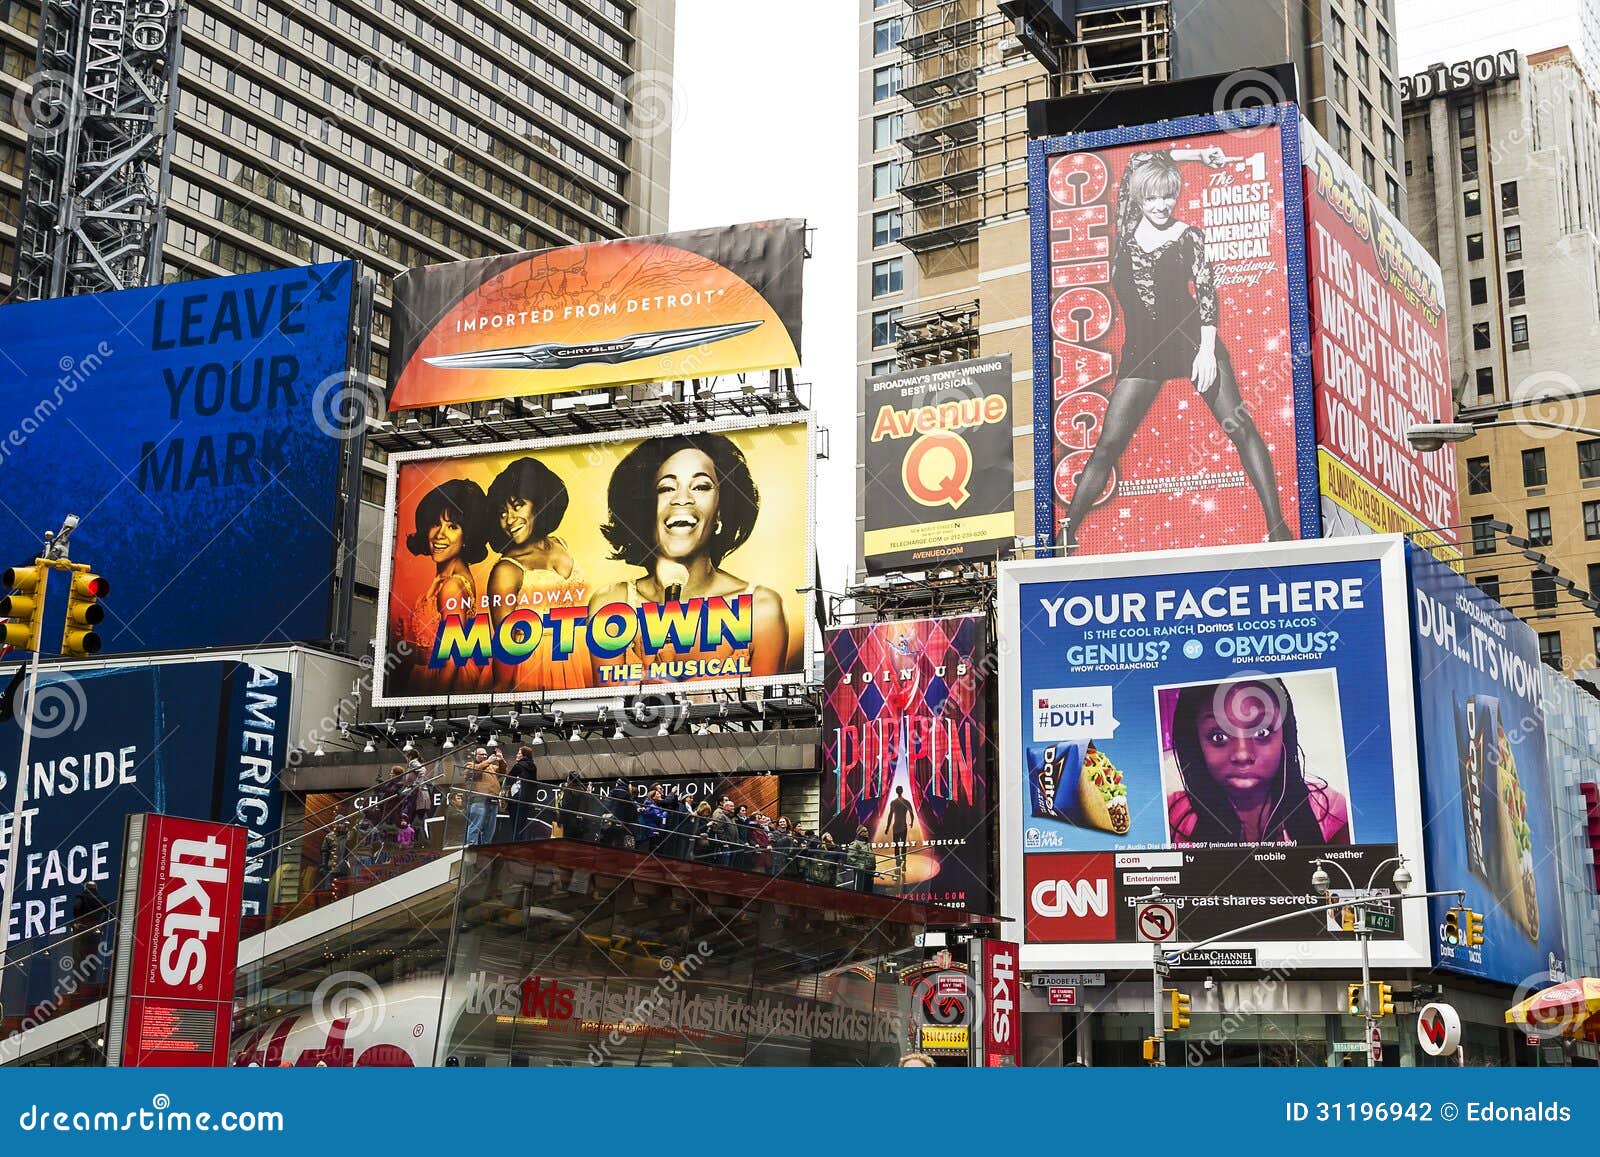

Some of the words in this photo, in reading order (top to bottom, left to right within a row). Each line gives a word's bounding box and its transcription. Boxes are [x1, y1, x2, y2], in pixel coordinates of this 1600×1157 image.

[1400, 49, 1518, 101] EDISON
[1209, 171, 1235, 187] The
[1203, 202, 1271, 227] RUNNING
[1204, 220, 1270, 243] AMERICAN
[1204, 238, 1271, 262] MUSICAL
[1213, 260, 1278, 276] Broadway
[1213, 271, 1263, 289] History!
[1315, 221, 1354, 300] THIS
[1356, 262, 1392, 336] NEW
[1389, 271, 1402, 293] WE
[1403, 285, 1420, 310] GET
[1421, 302, 1438, 328] YOU
[151, 280, 310, 351] LEAVE
[456, 308, 554, 334] IMPORTED
[563, 302, 617, 321] FROM
[1048, 152, 1116, 505] CHICAGO
[557, 344, 625, 356] CHRYSLER
[1318, 277, 1377, 373] WATCH
[1377, 333, 1409, 401] THE
[162, 354, 300, 420] YOUR
[873, 374, 931, 392] BROADWAY'S
[900, 387, 926, 397] BEST
[928, 377, 974, 394] MUSICAL
[1322, 336, 1367, 412] DROP
[870, 394, 1008, 443] Avenue
[138, 428, 294, 493] MARK
[901, 429, 974, 511] Q
[1324, 390, 1371, 472] YOUR
[1372, 431, 1421, 513] PANTS
[1423, 473, 1457, 540] SIZE
[1327, 462, 1358, 511] ALWAYS
[889, 536, 943, 549] TELECHARGE.COM
[911, 546, 965, 560] AVENUEQ.COM
[445, 596, 472, 612] ON
[481, 588, 586, 609] BROADWAY
[1040, 592, 1146, 628] YOUR
[1155, 585, 1251, 621] FACE
[1260, 578, 1365, 615] HERE
[431, 594, 754, 667] MOTOWN
[1084, 631, 1094, 640] IS
[1095, 630, 1118, 640] THE
[1118, 627, 1152, 638] COOL
[1197, 623, 1235, 634] Doritos
[1237, 620, 1276, 632] LOCOS
[1278, 617, 1318, 630] TACOS
[1067, 640, 1171, 665] GENIUS?
[1215, 631, 1340, 658] OBVIOUS?
[1231, 655, 1254, 664] #DUH
[1254, 652, 1322, 663] #COOLRANCHDLT
[1416, 588, 1471, 665] DUH...
[1470, 624, 1499, 681] IT'S
[1498, 643, 1545, 710] WOW!
[599, 661, 646, 684] THE
[650, 655, 752, 680] MUSICAL
[843, 670, 914, 686] JOIN
[934, 663, 968, 678] US
[1070, 663, 1094, 673] #WOW
[1095, 661, 1160, 671] #COOLRANCHDLT
[1039, 710, 1095, 728] #DUH
[235, 664, 279, 886] AMERICAN
[832, 714, 975, 818] PIPPIN
[1044, 747, 1058, 817] Doritos
[160, 842, 168, 871] service
[872, 840, 917, 850] ROADWAY
[922, 838, 967, 847] MUSICAL
[1117, 856, 1141, 865] .com
[1185, 855, 1195, 863] tv
[1254, 852, 1287, 861] mobile
[1325, 850, 1364, 859] weather
[1127, 842, 1146, 850] Audio
[1209, 841, 1238, 849] (minutes
[1276, 840, 1298, 849] apply)
[26, 841, 110, 891] FACE
[159, 871, 165, 881] of
[1125, 875, 1177, 883] Entertainment
[157, 881, 165, 912] Theatre
[160, 835, 228, 987] tkts
[1031, 878, 1108, 918] CNN
[1191, 895, 1219, 906] cast
[1223, 893, 1267, 906] shares
[1269, 893, 1318, 906] secrets
[152, 912, 162, 959] Development
[1376, 916, 1384, 927] 47
[150, 958, 158, 984] Fund
[992, 951, 1014, 1044] tkts
[922, 1030, 969, 1044] DELICATESSE
